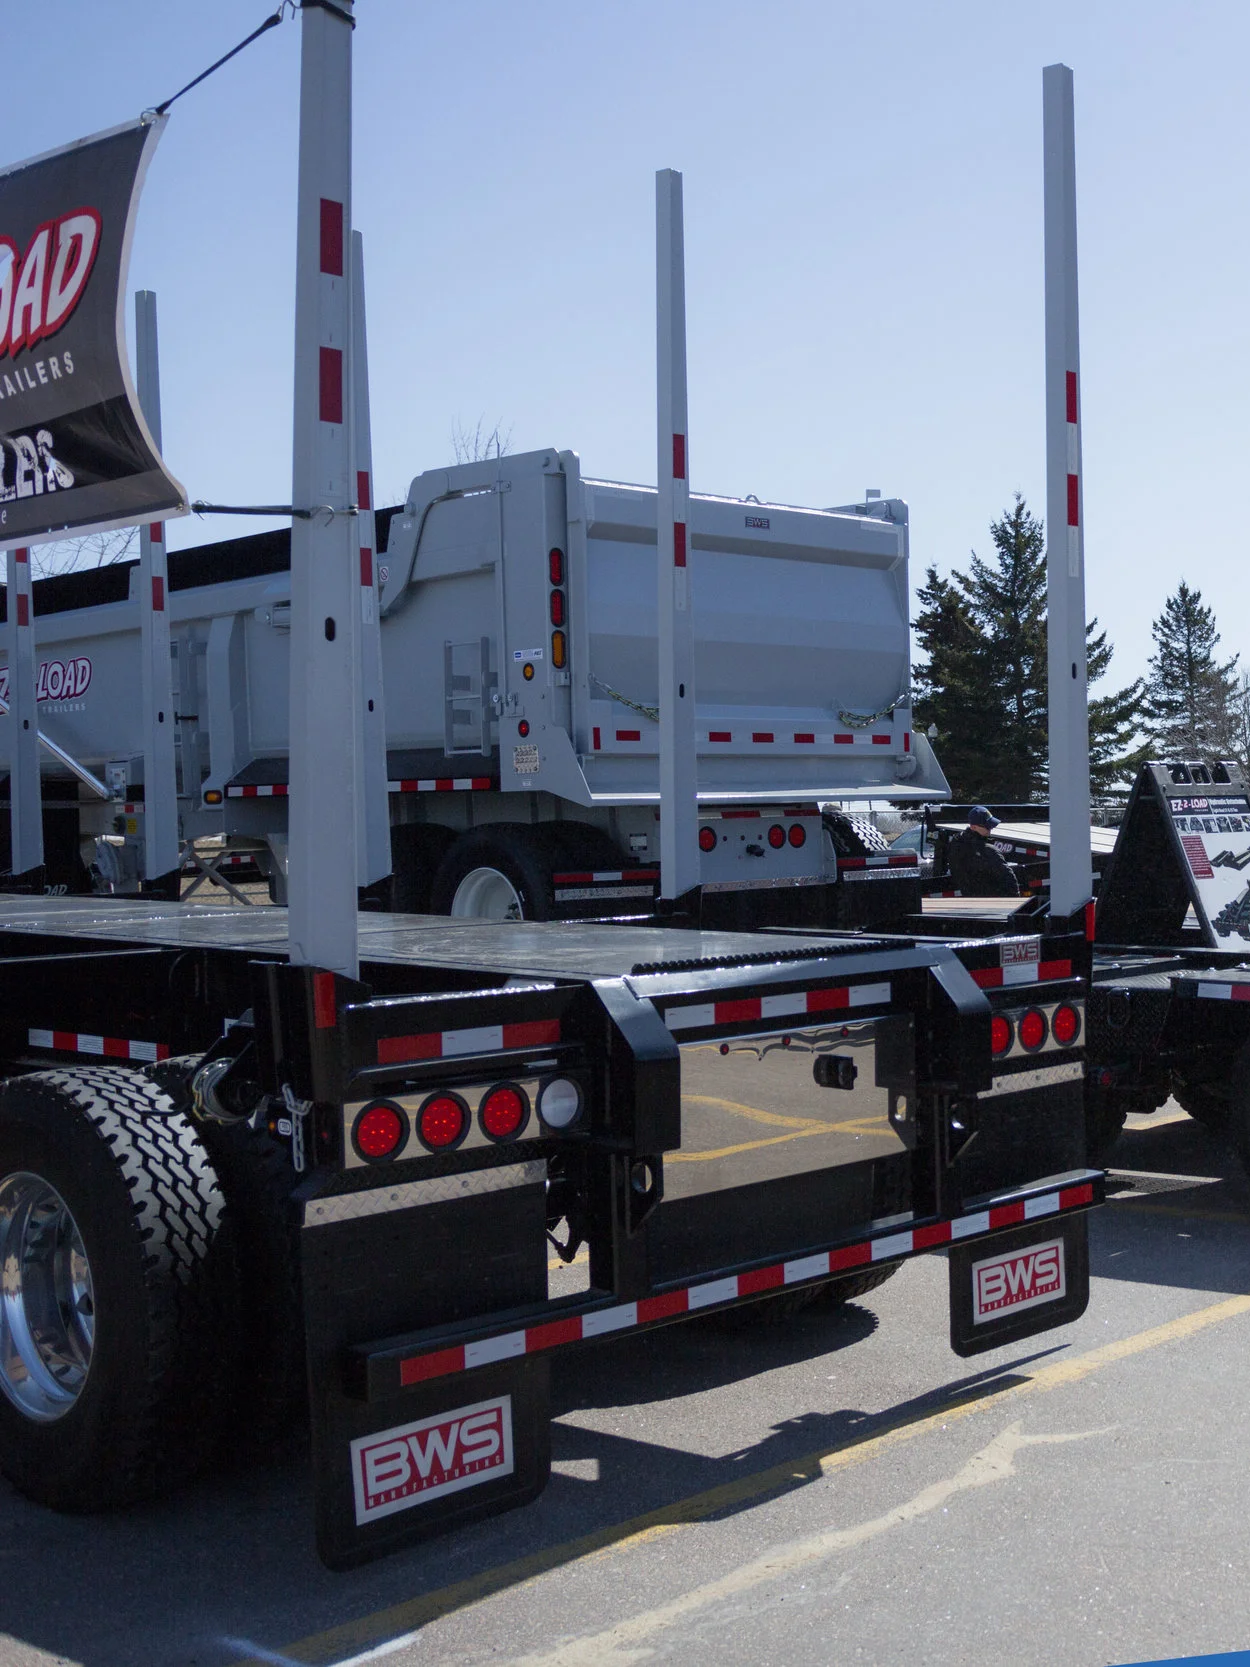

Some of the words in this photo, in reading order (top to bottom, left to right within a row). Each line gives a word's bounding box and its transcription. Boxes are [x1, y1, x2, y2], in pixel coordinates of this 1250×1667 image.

[0, 351, 75, 400] AILERS
[42, 703, 87, 714] TRAILERS
[1170, 798, 1209, 812] EZ-2-LOAD
[1002, 942, 1038, 960] BWS
[980, 1248, 1059, 1306] BWS
[981, 1282, 1059, 1313] MANUFACTURING
[365, 1410, 501, 1497] BWS
[368, 1455, 501, 1507] MANUFACTURING
